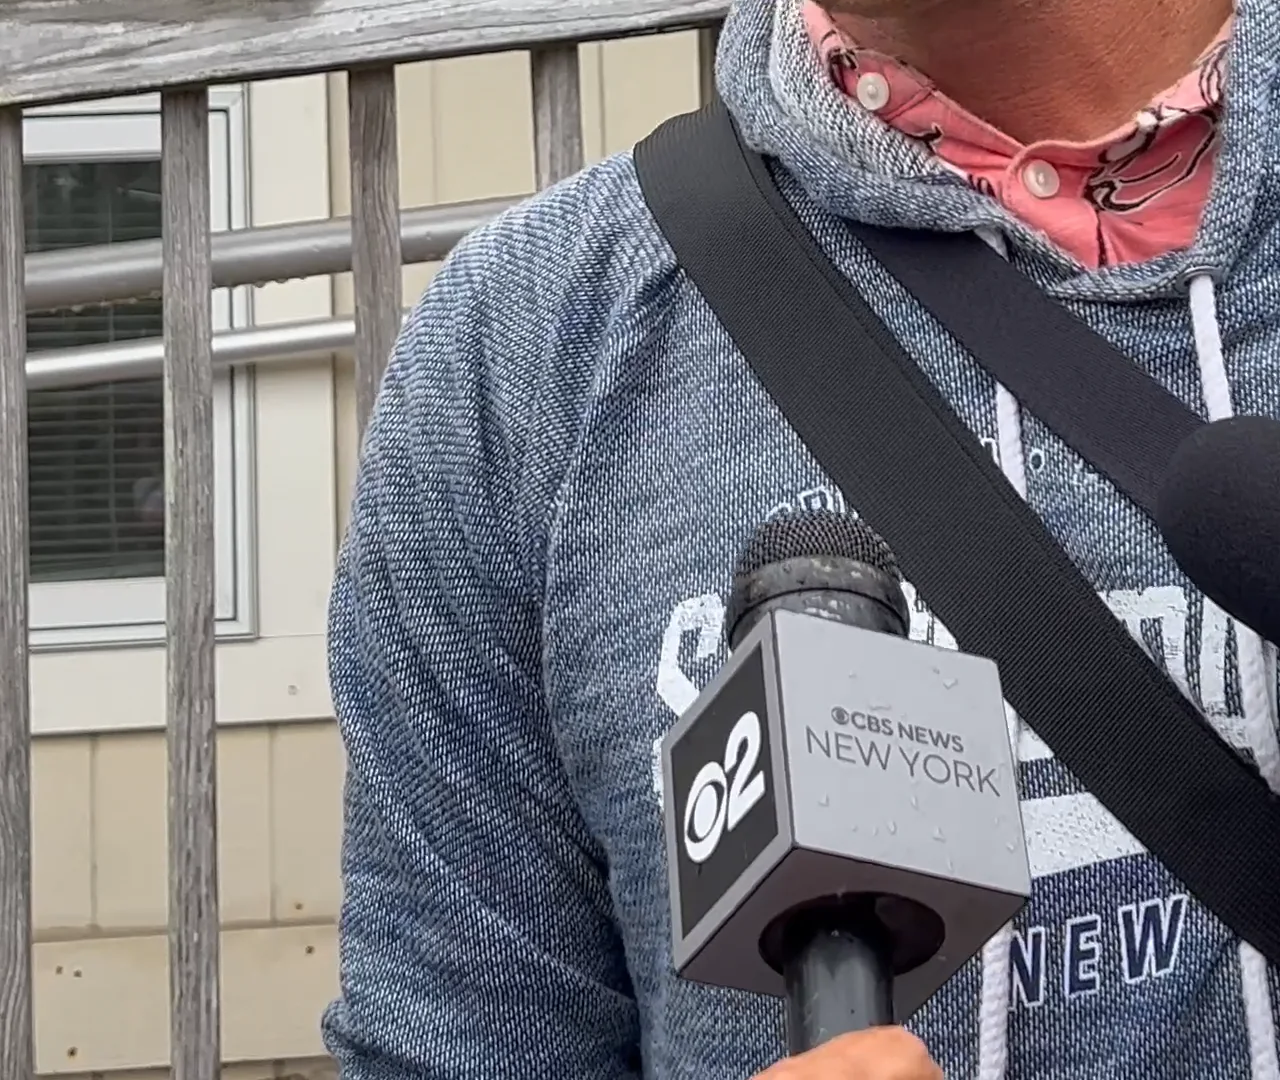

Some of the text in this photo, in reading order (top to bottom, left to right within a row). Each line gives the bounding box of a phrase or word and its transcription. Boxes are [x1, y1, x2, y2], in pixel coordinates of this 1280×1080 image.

[851, 711, 964, 753] CBS NEWS
[806, 725, 1000, 797] NEW YORK
